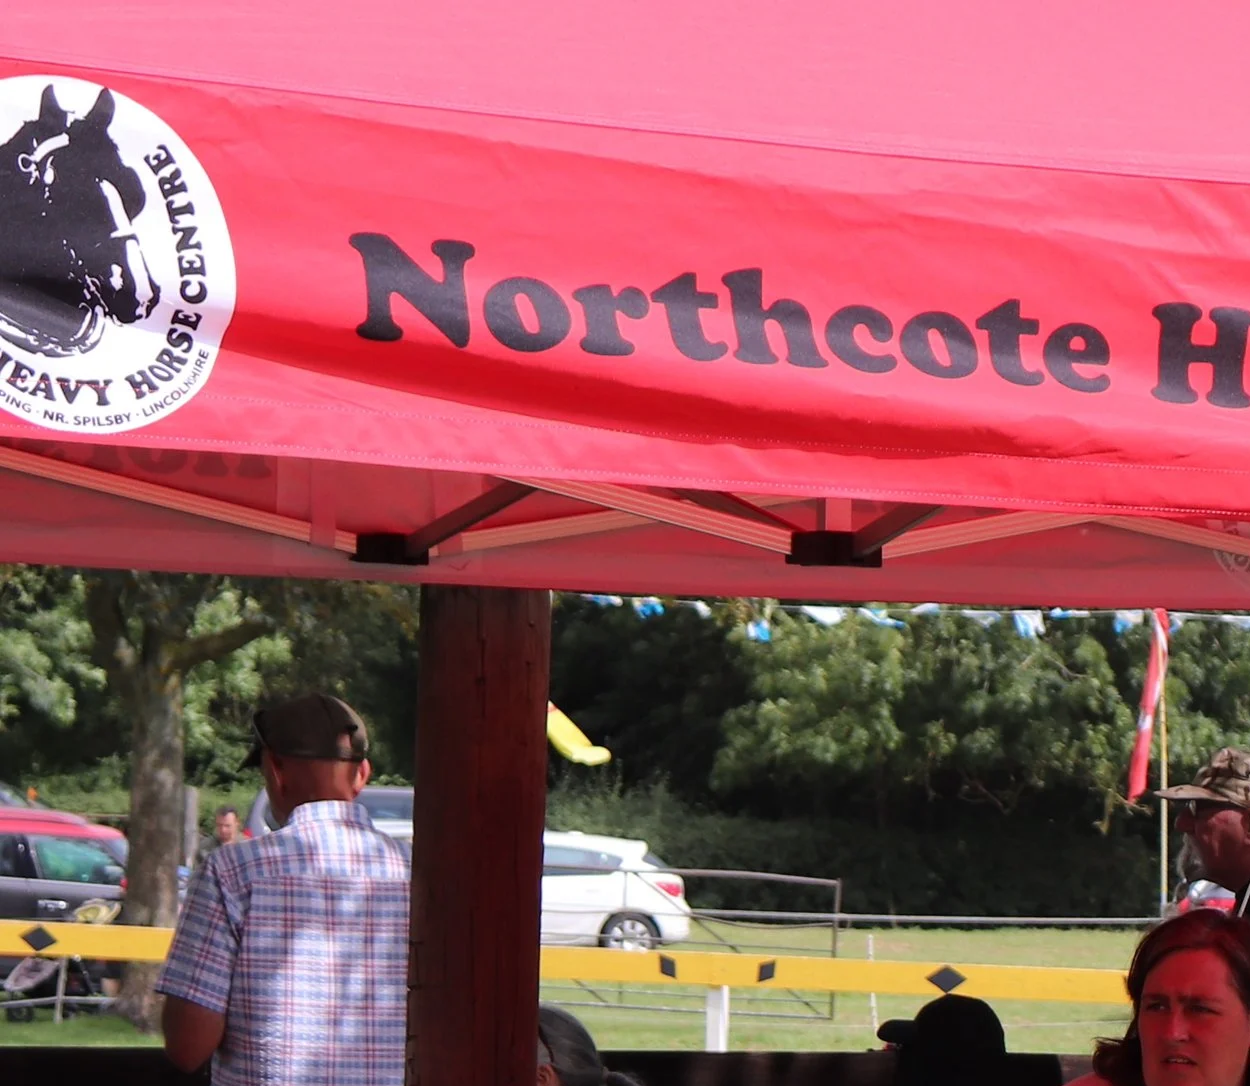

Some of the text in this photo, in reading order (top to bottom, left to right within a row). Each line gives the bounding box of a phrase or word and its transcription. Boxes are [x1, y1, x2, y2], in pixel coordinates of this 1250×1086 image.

[144, 144, 209, 306] CENTRE
[124, 308, 203, 400] HORSE
[348, 231, 1111, 394] Northcote
[43, 410, 69, 425] NR.
[74, 412, 132, 426] SPILSBY
[142, 348, 210, 418] LINCOLNSHIRE
